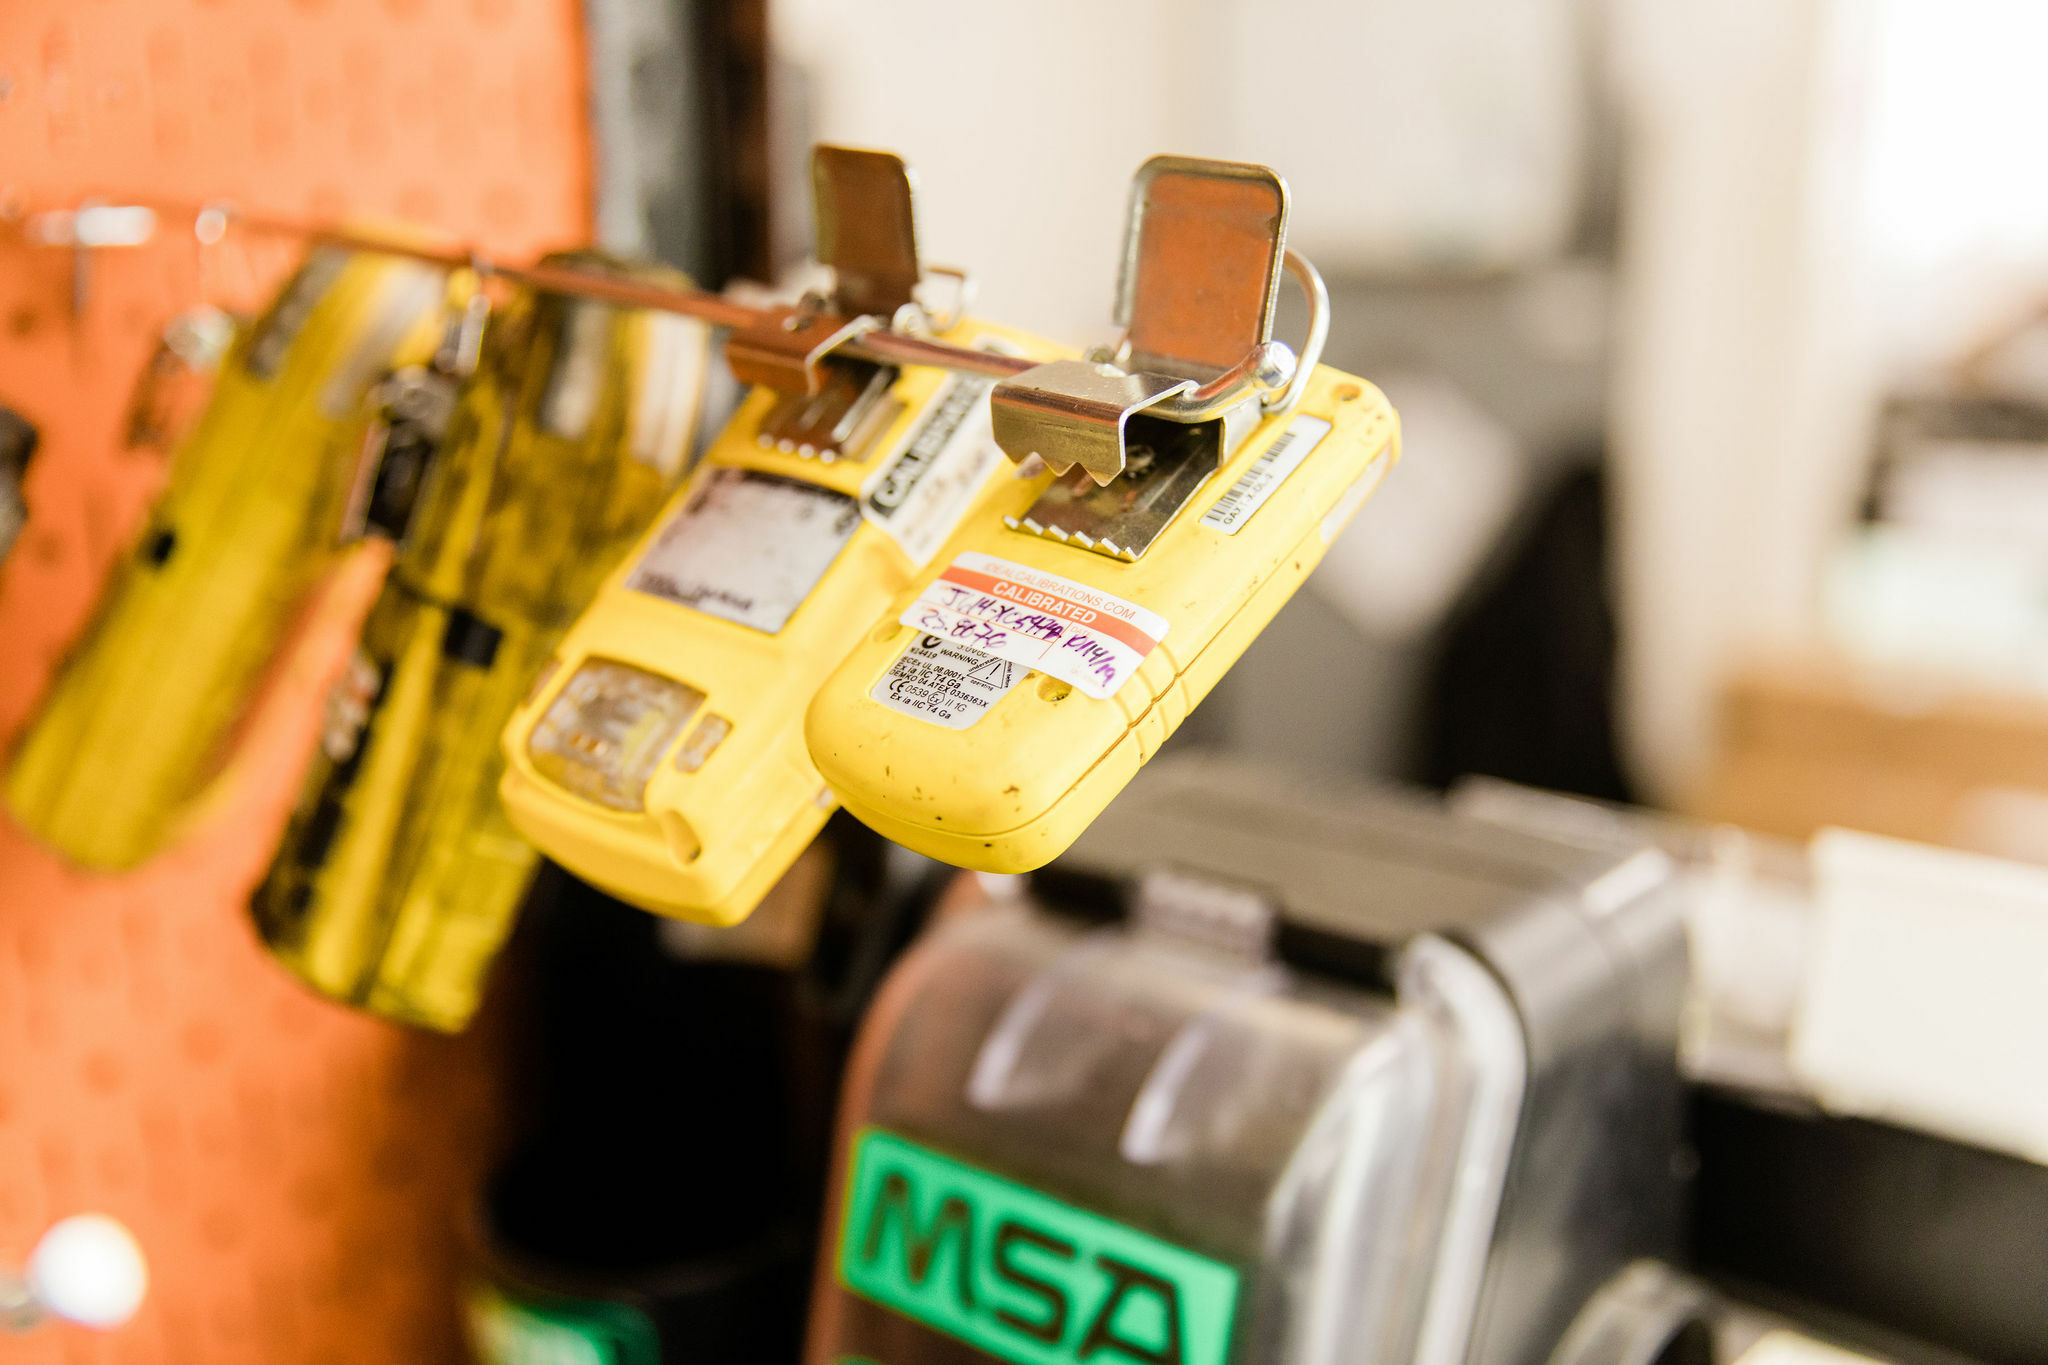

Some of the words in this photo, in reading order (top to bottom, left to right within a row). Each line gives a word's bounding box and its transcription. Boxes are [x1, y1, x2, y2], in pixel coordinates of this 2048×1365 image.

[984, 561, 1137, 621] IDEALCALIBRATIONS.COM
[992, 580, 1098, 624] CALIBRATED
[922, 661, 932, 670] UL
[940, 648, 979, 666] WARNING
[888, 669, 917, 682] DEMKO
[917, 677, 928, 685] 04
[928, 680, 949, 693] ATEX
[950, 689, 989, 708] 0336363X
[894, 661, 905, 671] Ex
[907, 665, 917, 674] ia
[918, 668, 931, 678] IIC
[934, 672, 945, 683] T4
[946, 678, 961, 689] Ga
[890, 691, 901, 701] Ex
[903, 696, 912, 705] ia
[913, 698, 924, 709] IIC
[926, 704, 938, 714] T4
[938, 709, 952, 720] Ga
[905, 684, 928, 698] 0539
[955, 701, 968, 713] 1G
[862, 1171, 1185, 1365] MSA
